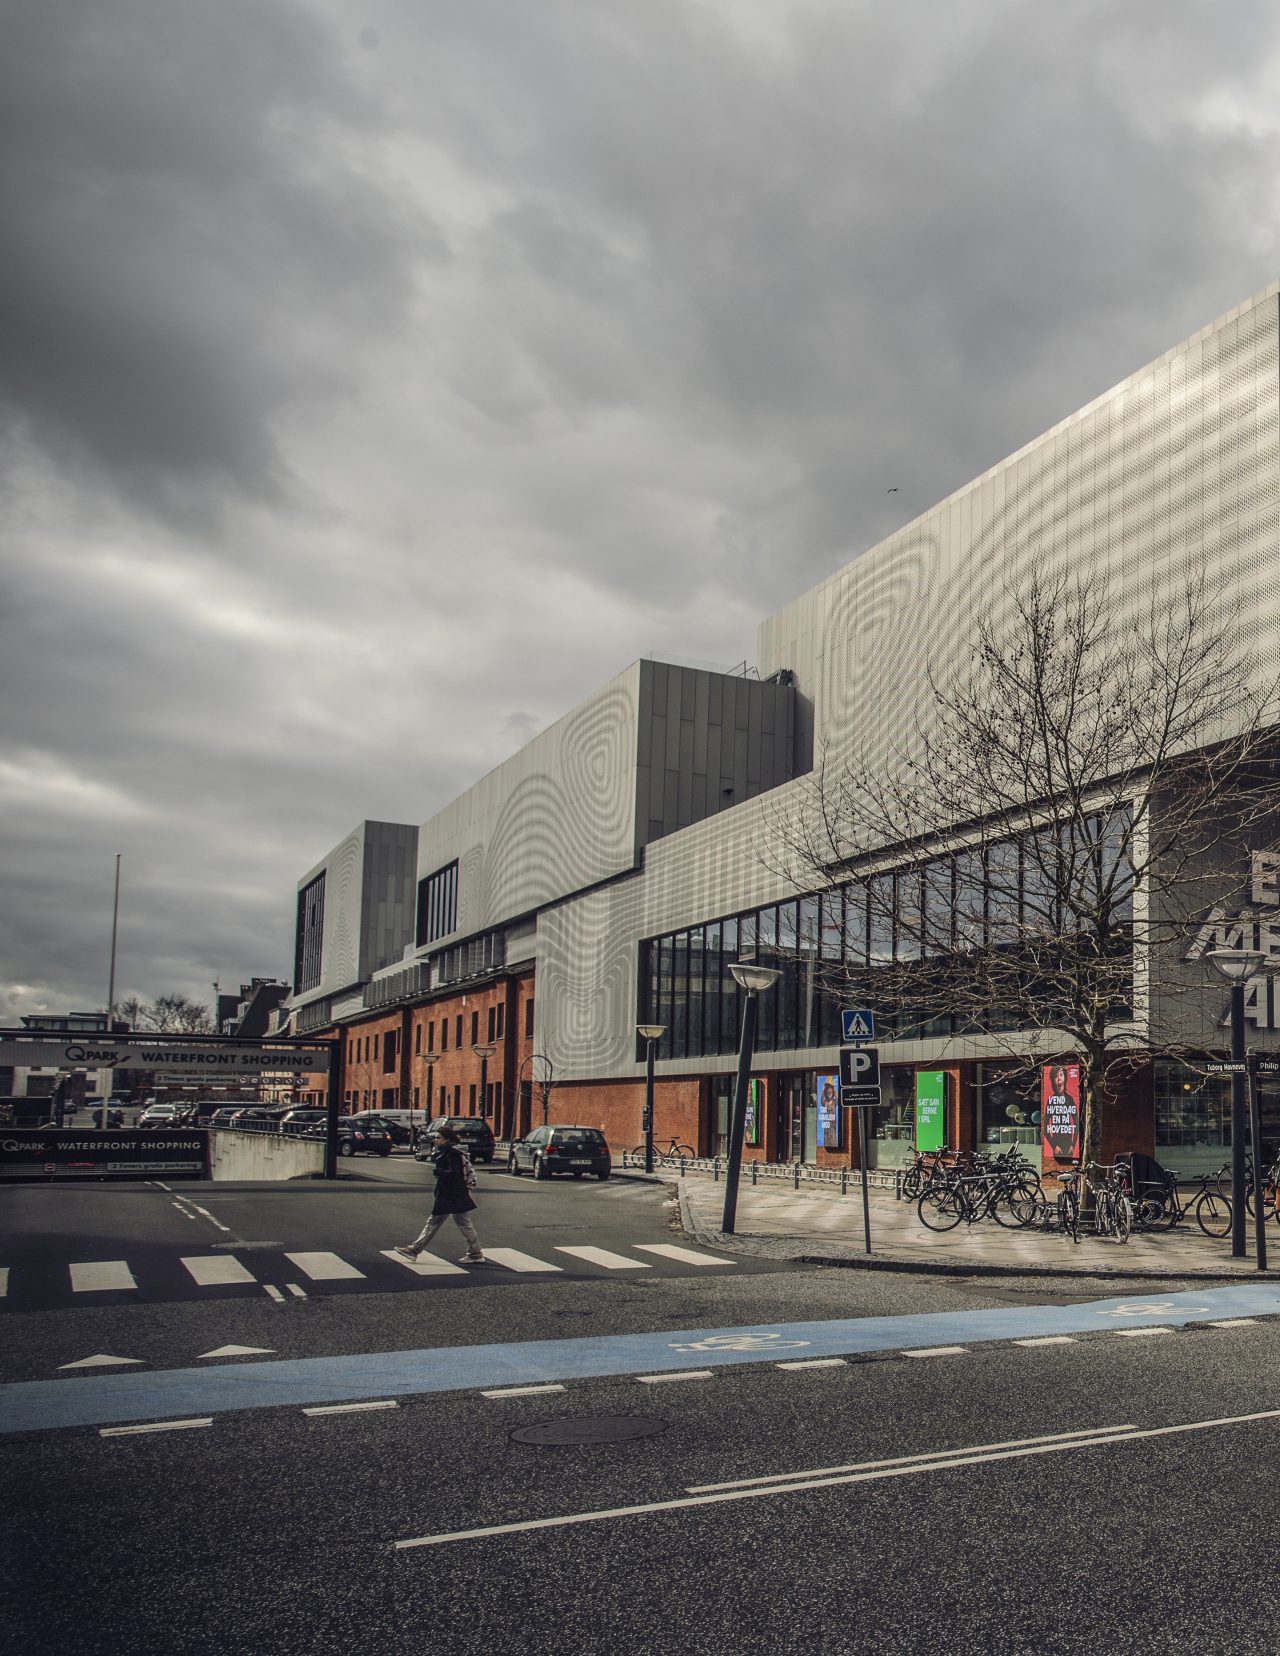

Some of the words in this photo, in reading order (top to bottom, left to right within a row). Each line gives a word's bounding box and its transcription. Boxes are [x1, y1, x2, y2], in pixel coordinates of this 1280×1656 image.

[141, 1051, 239, 1065] WATERFRONT
[241, 1053, 314, 1067] SHOPPING
[850, 1053, 870, 1082] P
[1207, 1064, 1223, 1072] Tuborg
[1260, 1062, 1279, 1071] Philip
[930, 1098, 940, 1106] SAN
[1048, 1096, 1066, 1105] VEND
[1046, 1105, 1076, 1114] HVERDAG
[1052, 1115, 1061, 1124] EN
[1061, 1113, 1070, 1124] PÅ
[1046, 1125, 1076, 1134] HOVEDET
[57, 1142, 137, 1151] WATERFRONT
[140, 1141, 201, 1150] SHOPPING
